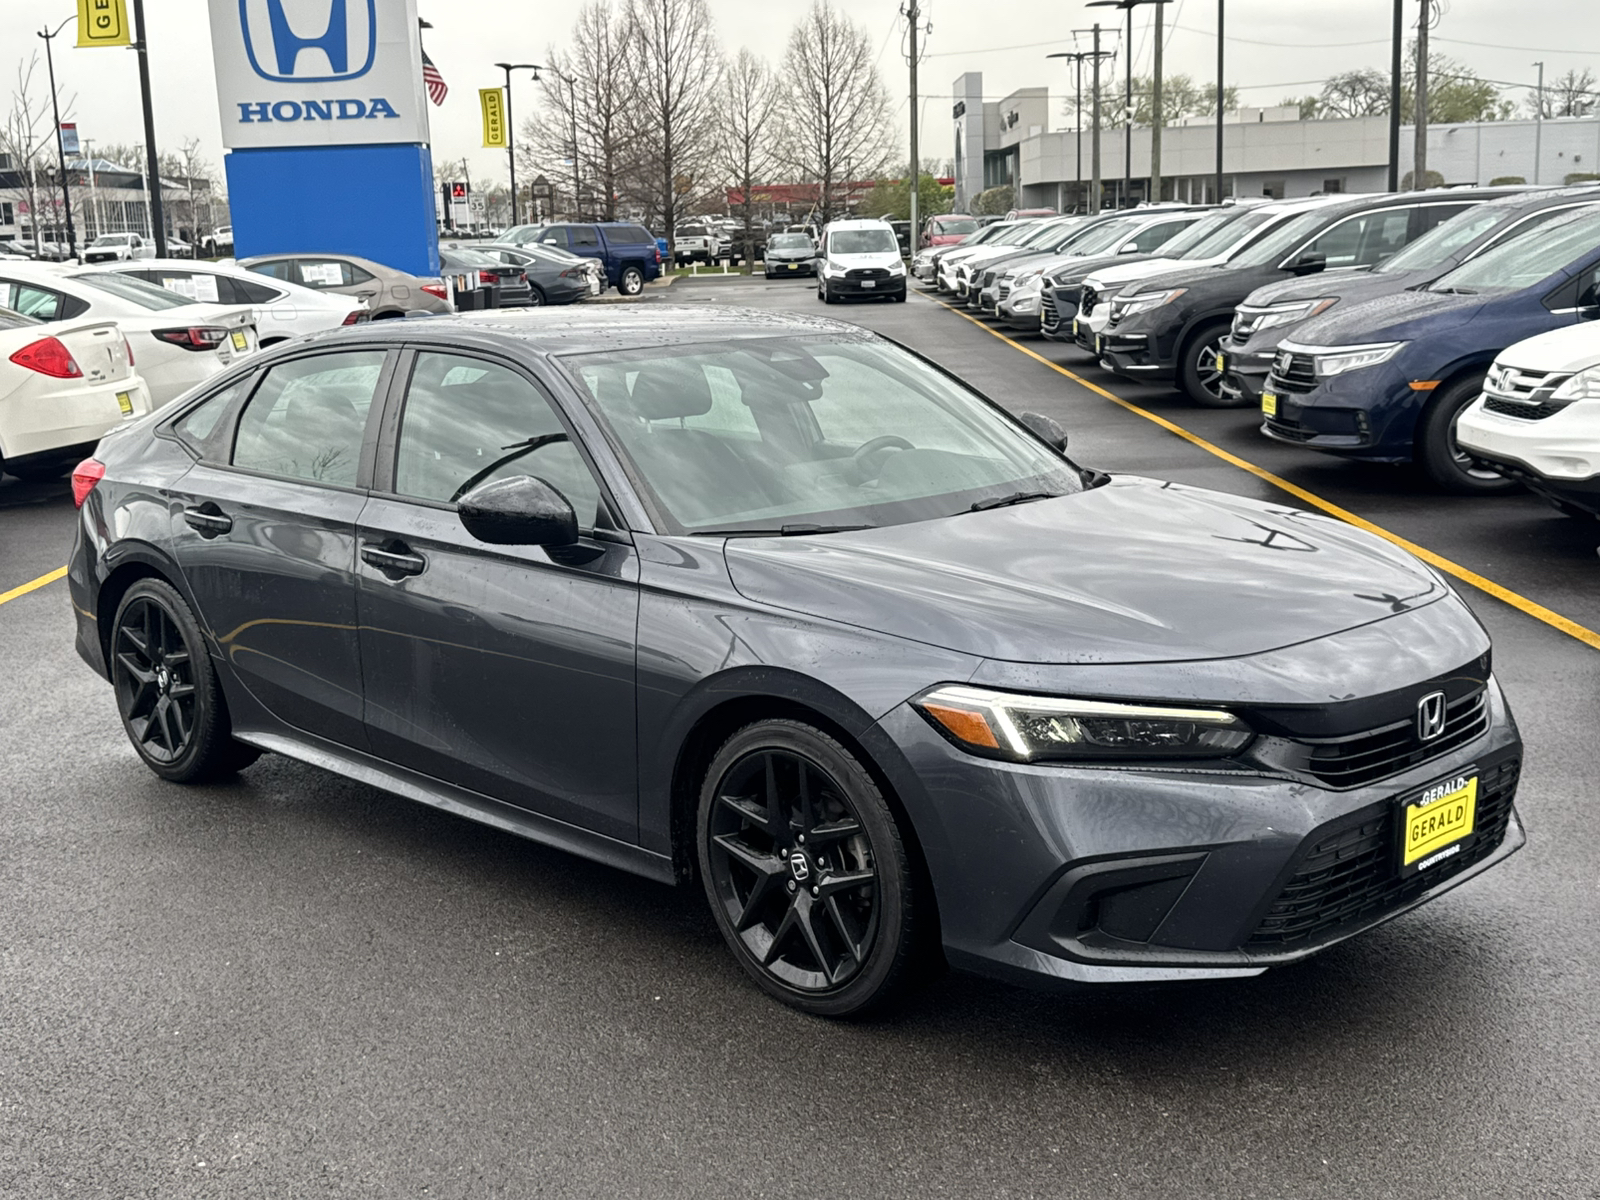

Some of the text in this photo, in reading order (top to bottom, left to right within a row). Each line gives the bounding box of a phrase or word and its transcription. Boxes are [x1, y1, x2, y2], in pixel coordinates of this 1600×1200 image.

[237, 98, 400, 123] HONDA
[488, 95, 499, 140] GERALD
[471, 202, 484, 210] 35
[1422, 777, 1465, 805] GERALD
[1412, 805, 1464, 842] GERALD
